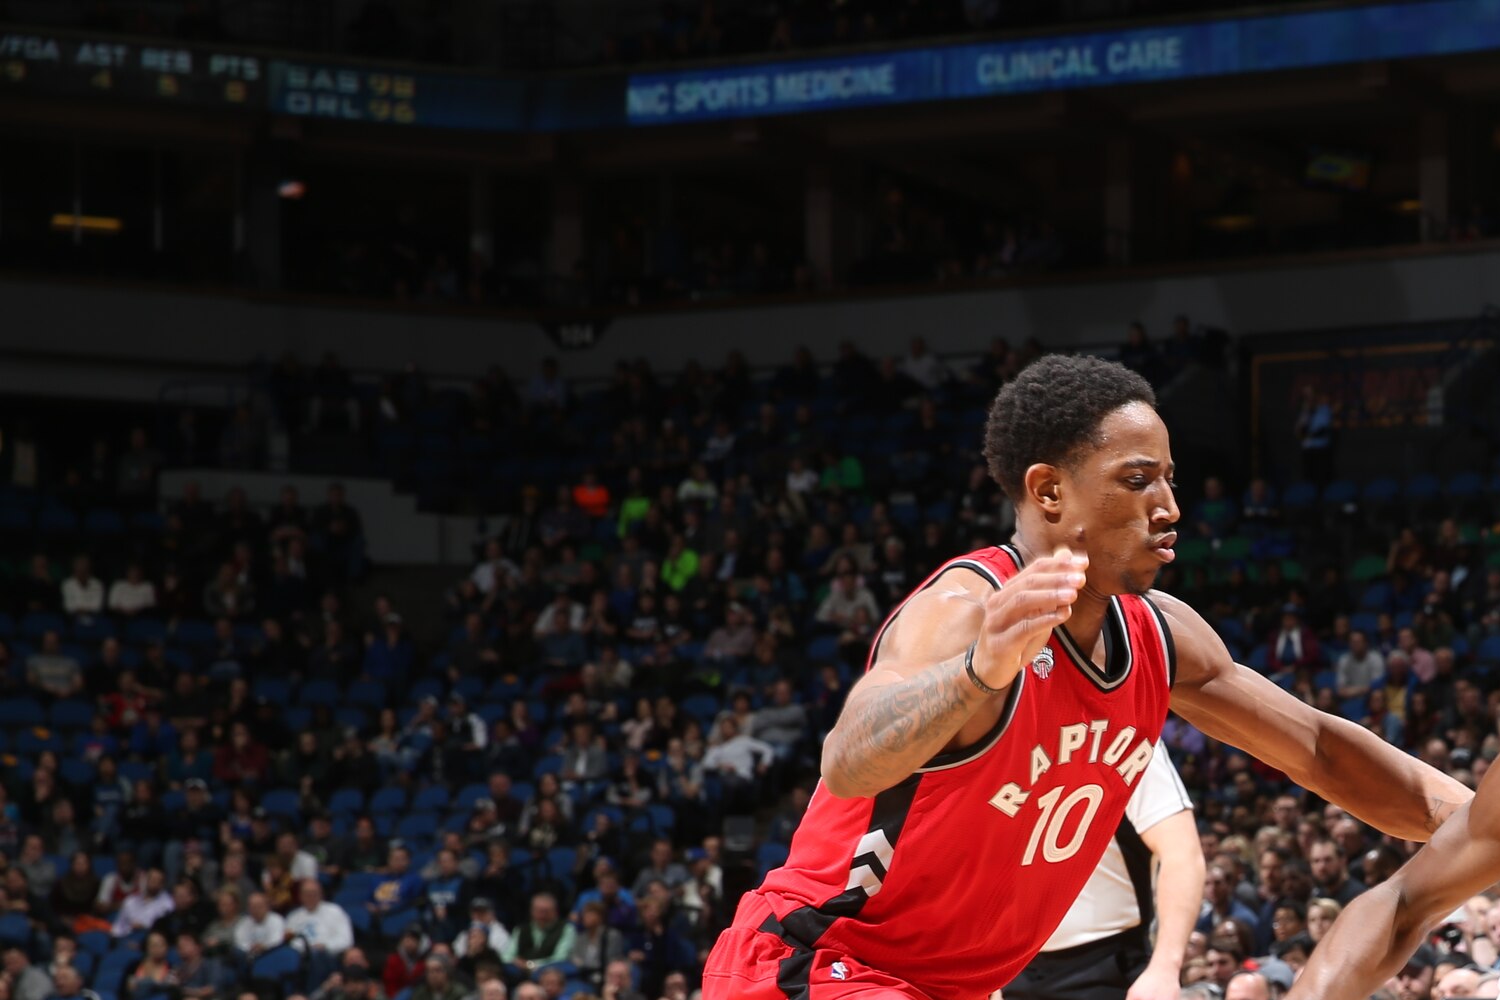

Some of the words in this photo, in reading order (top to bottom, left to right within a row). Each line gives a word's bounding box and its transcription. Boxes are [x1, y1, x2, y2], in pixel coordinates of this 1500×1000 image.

[76, 42, 129, 66] AST
[208, 53, 260, 81] PTS
[286, 65, 360, 95] SAS
[977, 47, 1099, 86] CLINICAL
[1105, 36, 1183, 75] CARE
[285, 91, 361, 120] ORL
[673, 75, 768, 114] SPORTS
[773, 63, 895, 106] MEDICINE
[1020, 783, 1104, 866] 10
